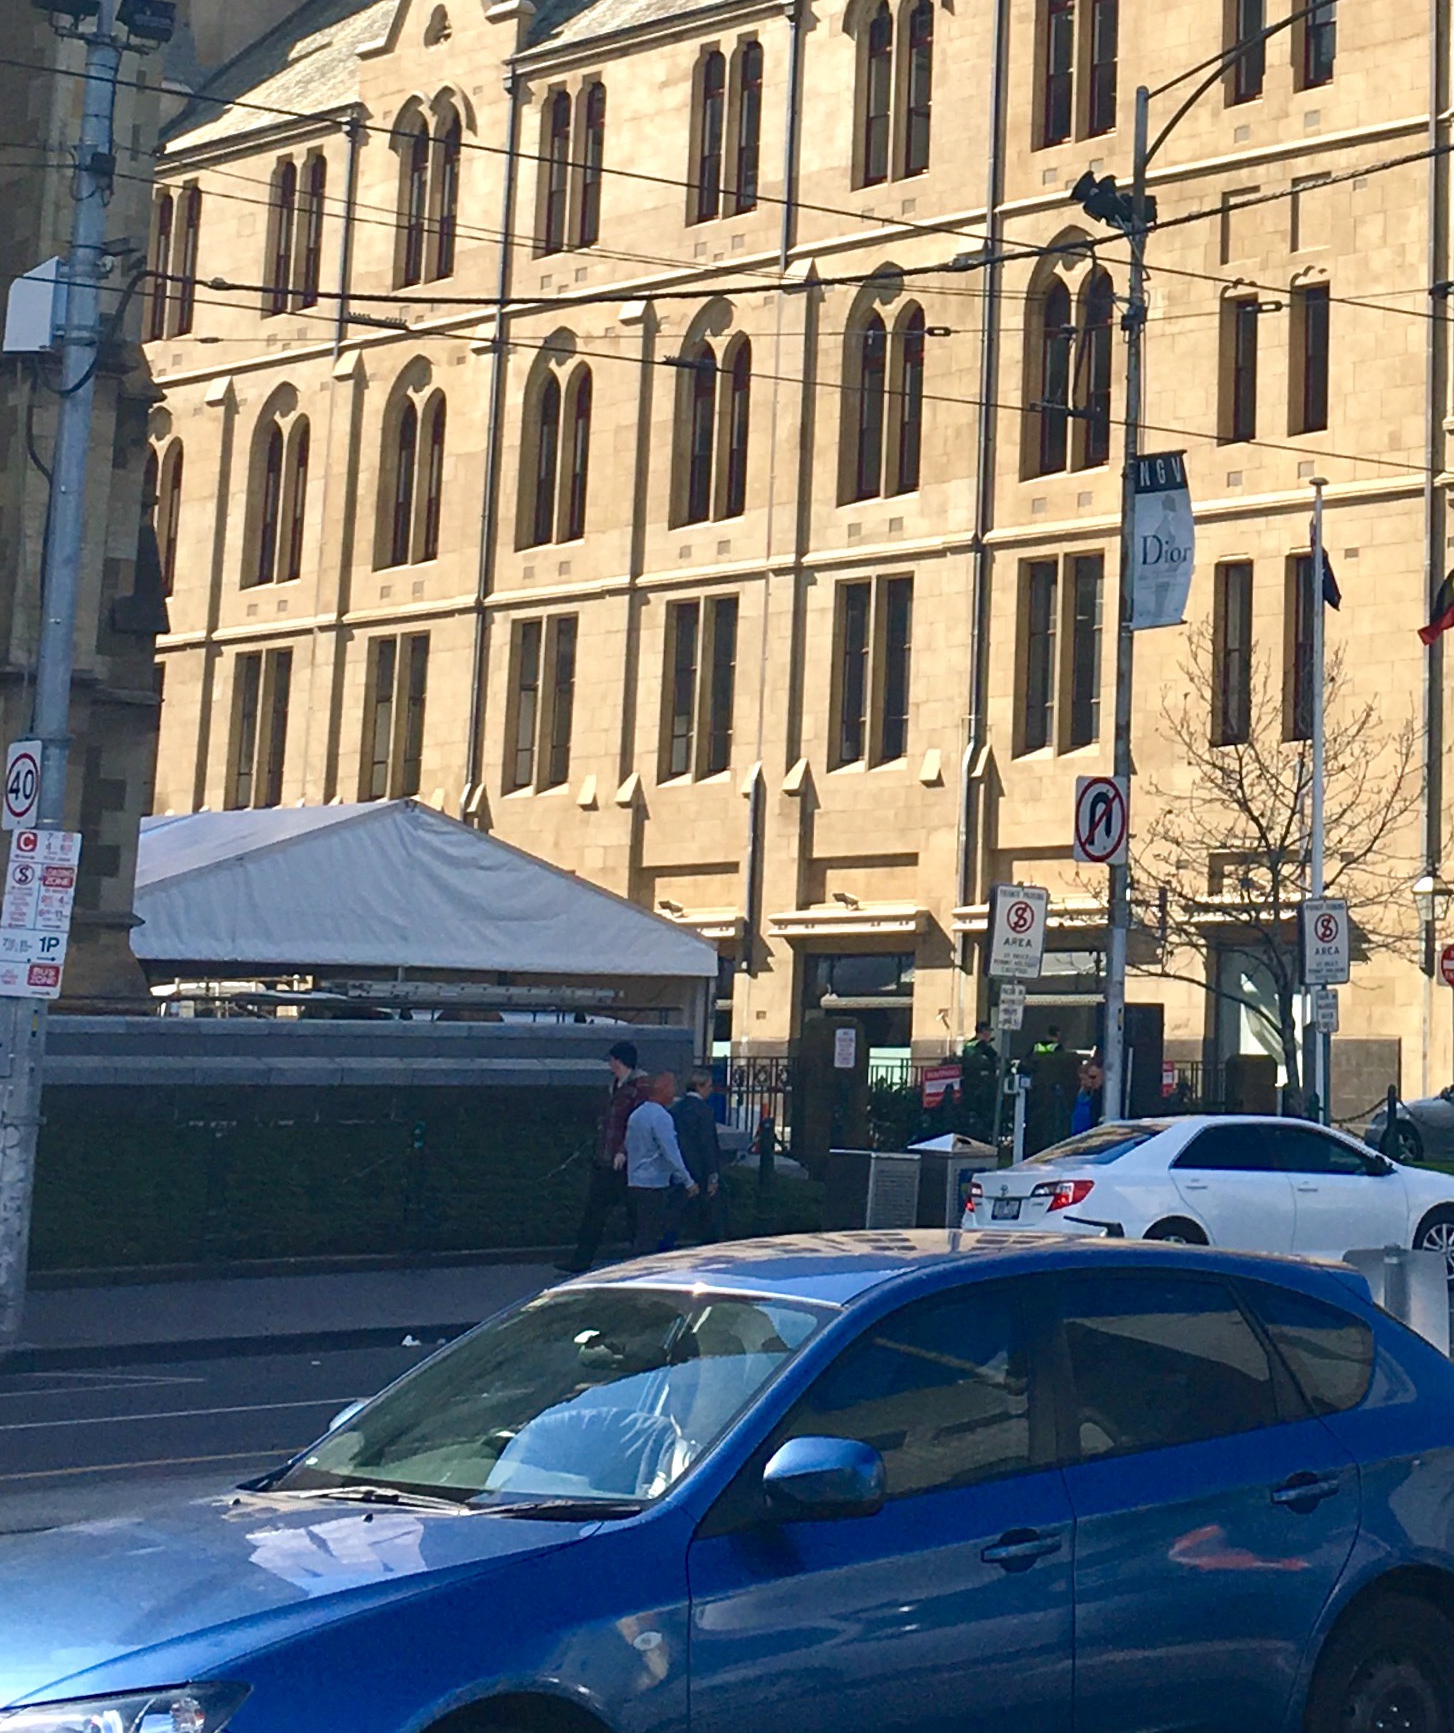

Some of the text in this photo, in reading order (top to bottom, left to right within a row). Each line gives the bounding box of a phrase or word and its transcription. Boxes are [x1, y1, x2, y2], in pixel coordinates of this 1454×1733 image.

[1141, 535, 1192, 565] Dior
[8, 769, 35, 800] 40
[45, 876, 73, 886] ZONE
[39, 936, 60, 952] 1P
[1003, 937, 1033, 948] AREA
[1314, 946, 1340, 955] AREA
